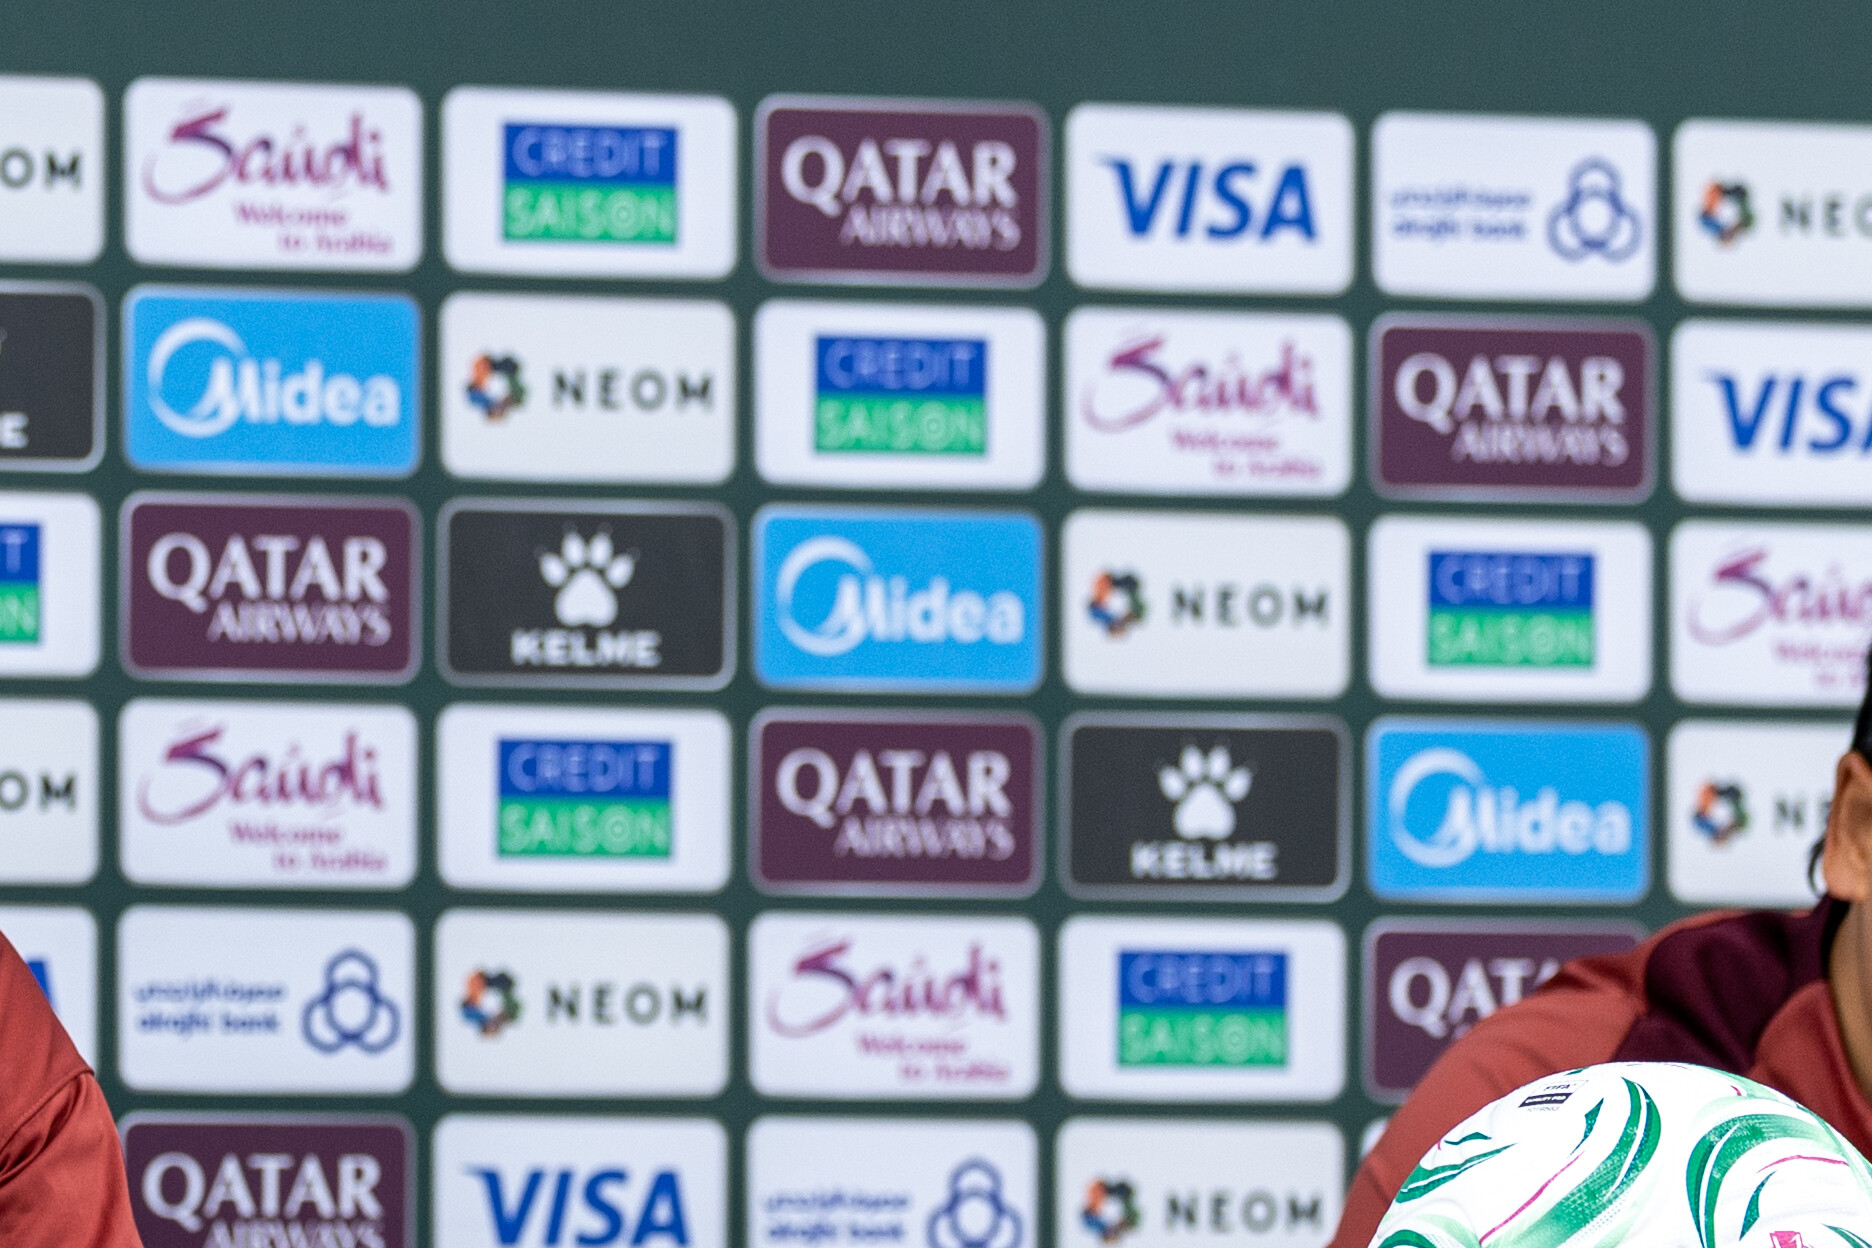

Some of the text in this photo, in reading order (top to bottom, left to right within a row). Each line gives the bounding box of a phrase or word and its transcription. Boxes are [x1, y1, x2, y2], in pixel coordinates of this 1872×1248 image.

[515, 128, 664, 176] CREDIT
[782, 137, 1016, 218] QATAR
[1095, 155, 1319, 243] VISA
[507, 190, 674, 238] SAISON
[841, 203, 1016, 248] AIRWAYS
[1780, 193, 1872, 241] NEO
[827, 341, 973, 388] CREDIT
[552, 369, 713, 411] NEOM
[1395, 356, 1623, 435] QATAR
[819, 403, 983, 449] SAISON
[1453, 421, 1624, 465] AIRWAYS
[147, 534, 387, 614] QATAR
[1439, 556, 1581, 603] CREDIT
[208, 600, 388, 644] AIRWAYS
[1171, 586, 1328, 626] NEOM
[512, 629, 659, 665] KELME
[1431, 618, 1591, 663] SAISON
[510, 744, 659, 790] CREDIT
[777, 750, 1010, 828] QATAR
[502, 807, 669, 852] SAISON
[836, 815, 1011, 858] AIRWAYS
[1132, 843, 1275, 877] KELME
[1130, 956, 1275, 1001] CREDIT
[1390, 957, 1562, 1039] QAT
[547, 984, 707, 1024] NEOM
[1122, 1018, 1285, 1062] SAISON
[142, 1154, 382, 1231] QATAR
[464, 1166, 693, 1248] VISA
[1166, 1193, 1322, 1231] NEOM
